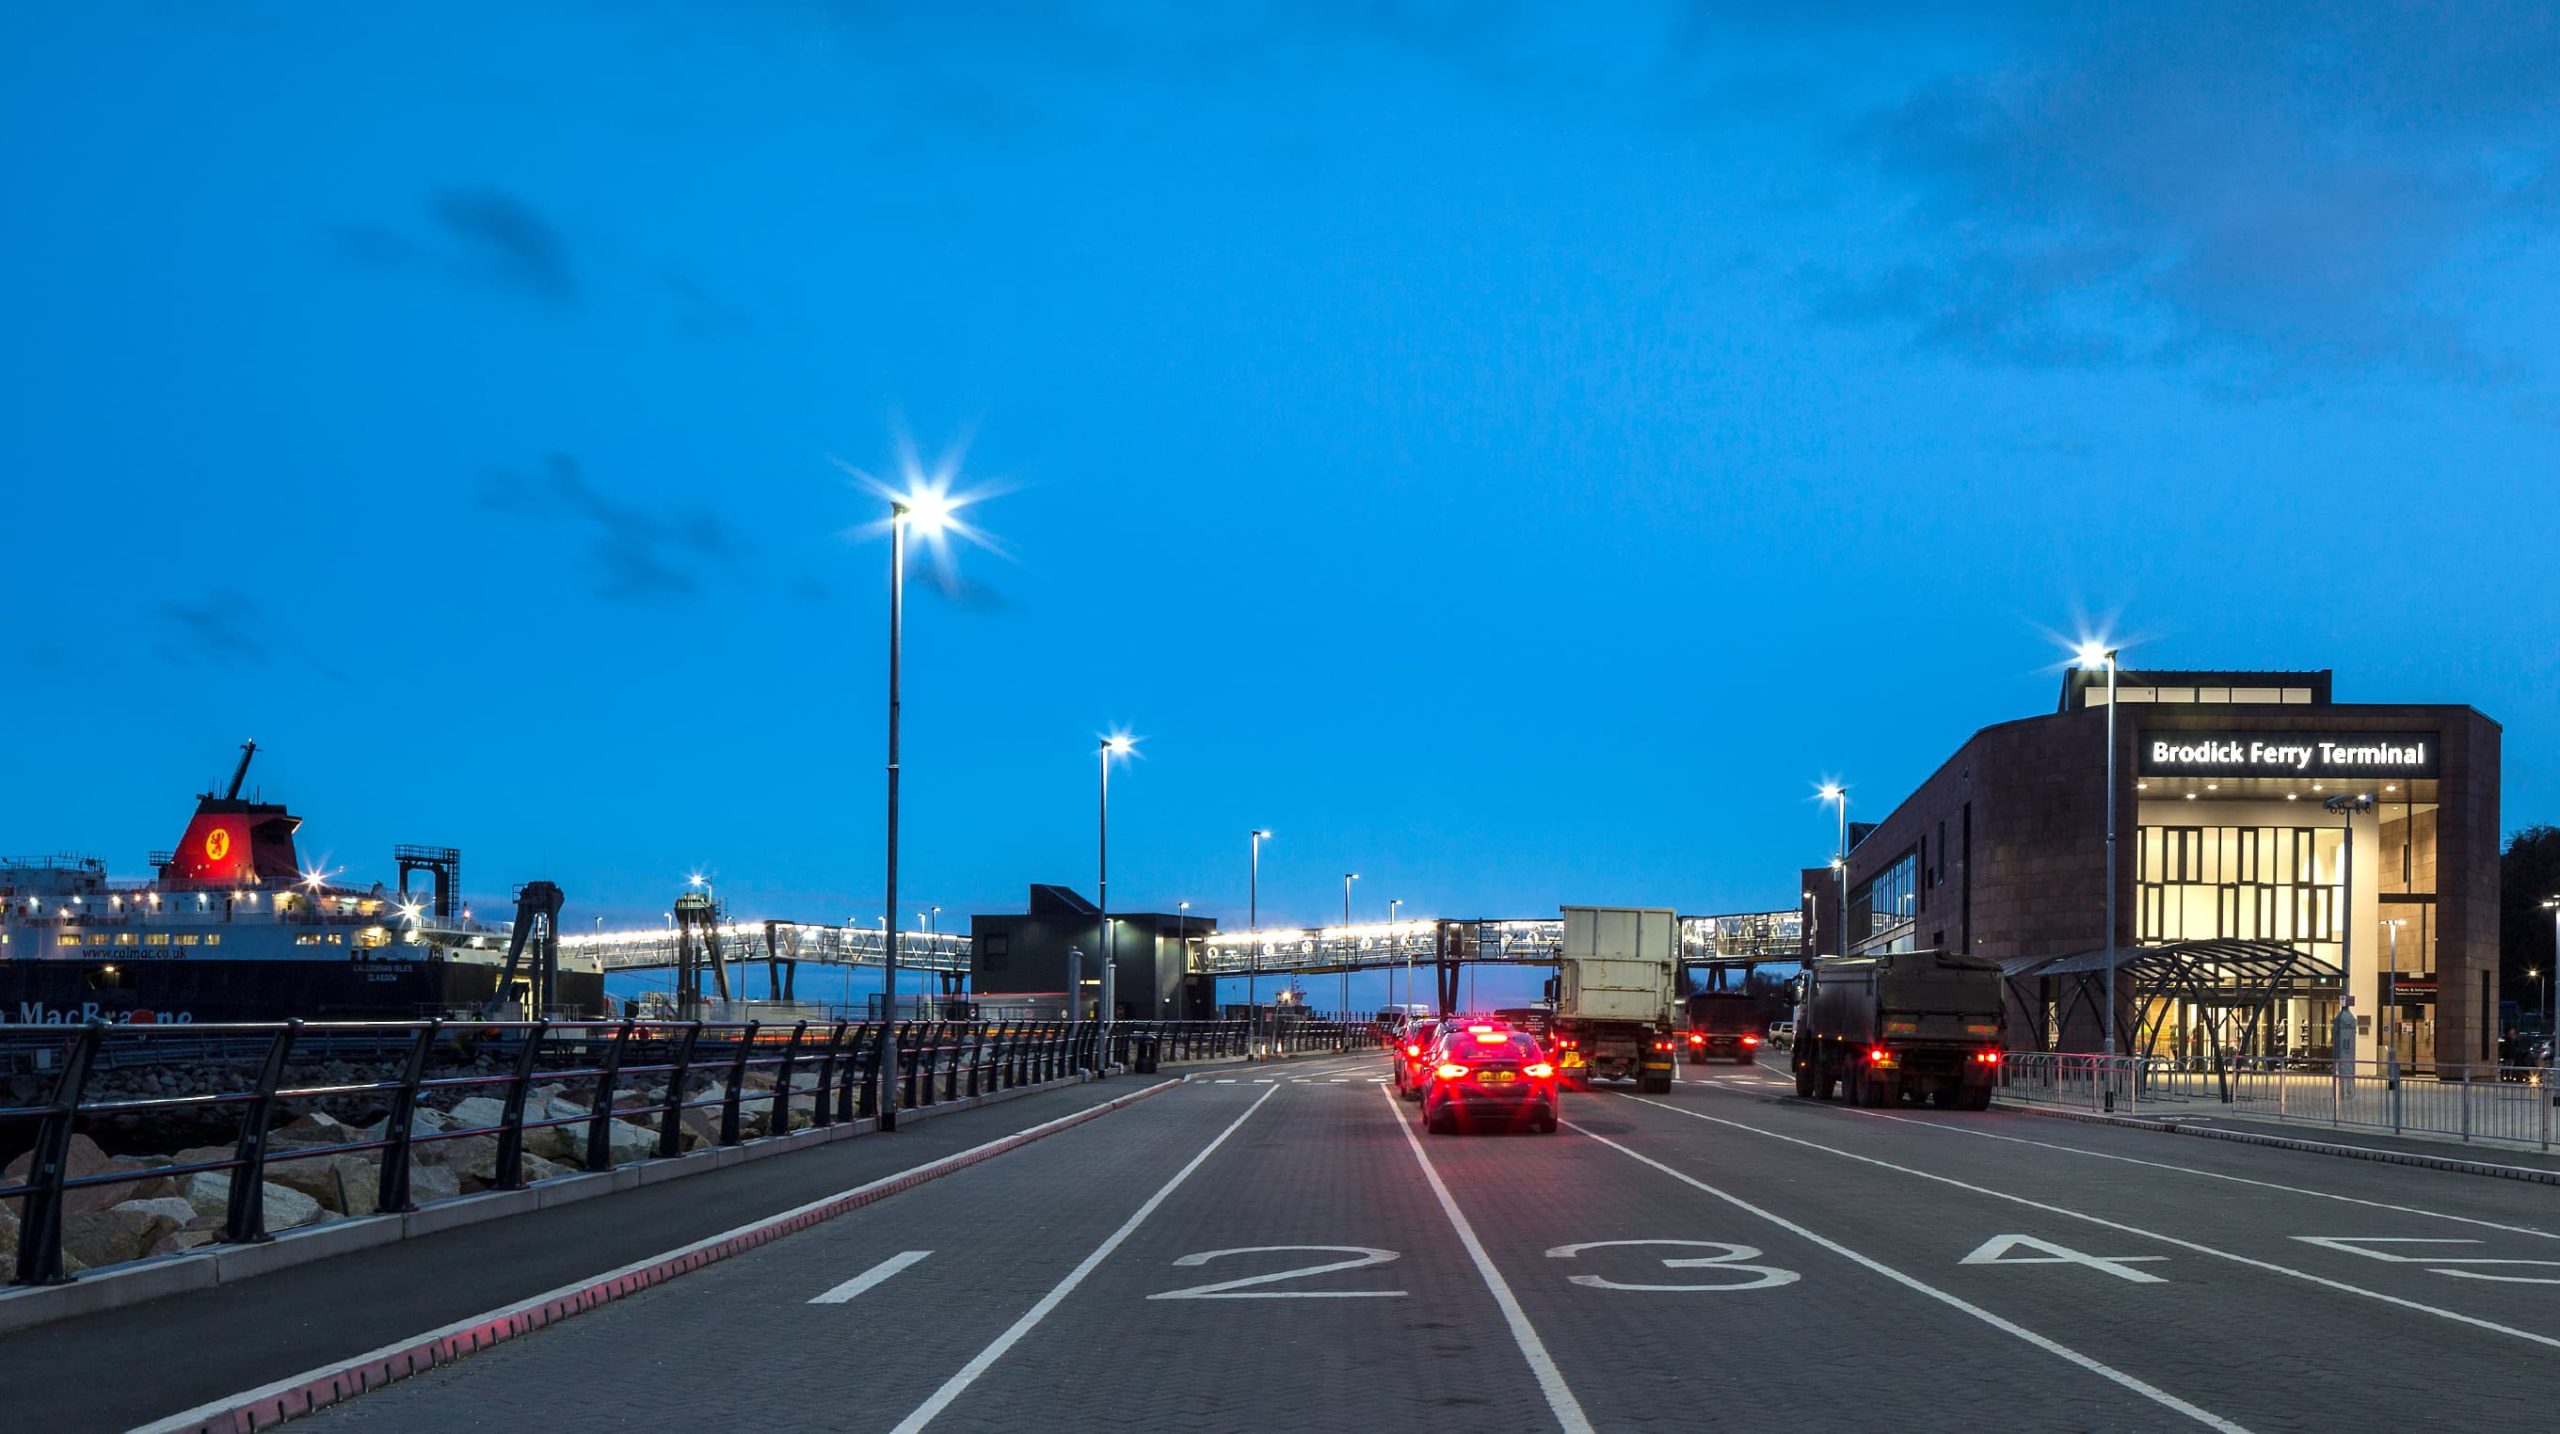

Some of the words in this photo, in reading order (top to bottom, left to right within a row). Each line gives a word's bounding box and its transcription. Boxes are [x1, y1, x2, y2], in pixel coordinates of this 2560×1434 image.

[2153, 741, 2244, 763] Brodick
[2250, 742, 2312, 769] Ferry
[2318, 743, 2424, 764] Terminal
[82, 947, 186, 959] www.calmac.co.uk
[20, 1001, 193, 1024] MacBrane
[806, 1251, 935, 1303] 1
[1145, 1246, 1408, 1299] 2
[1546, 1239, 1801, 1291] 3
[1957, 1234, 2171, 1283] 4
